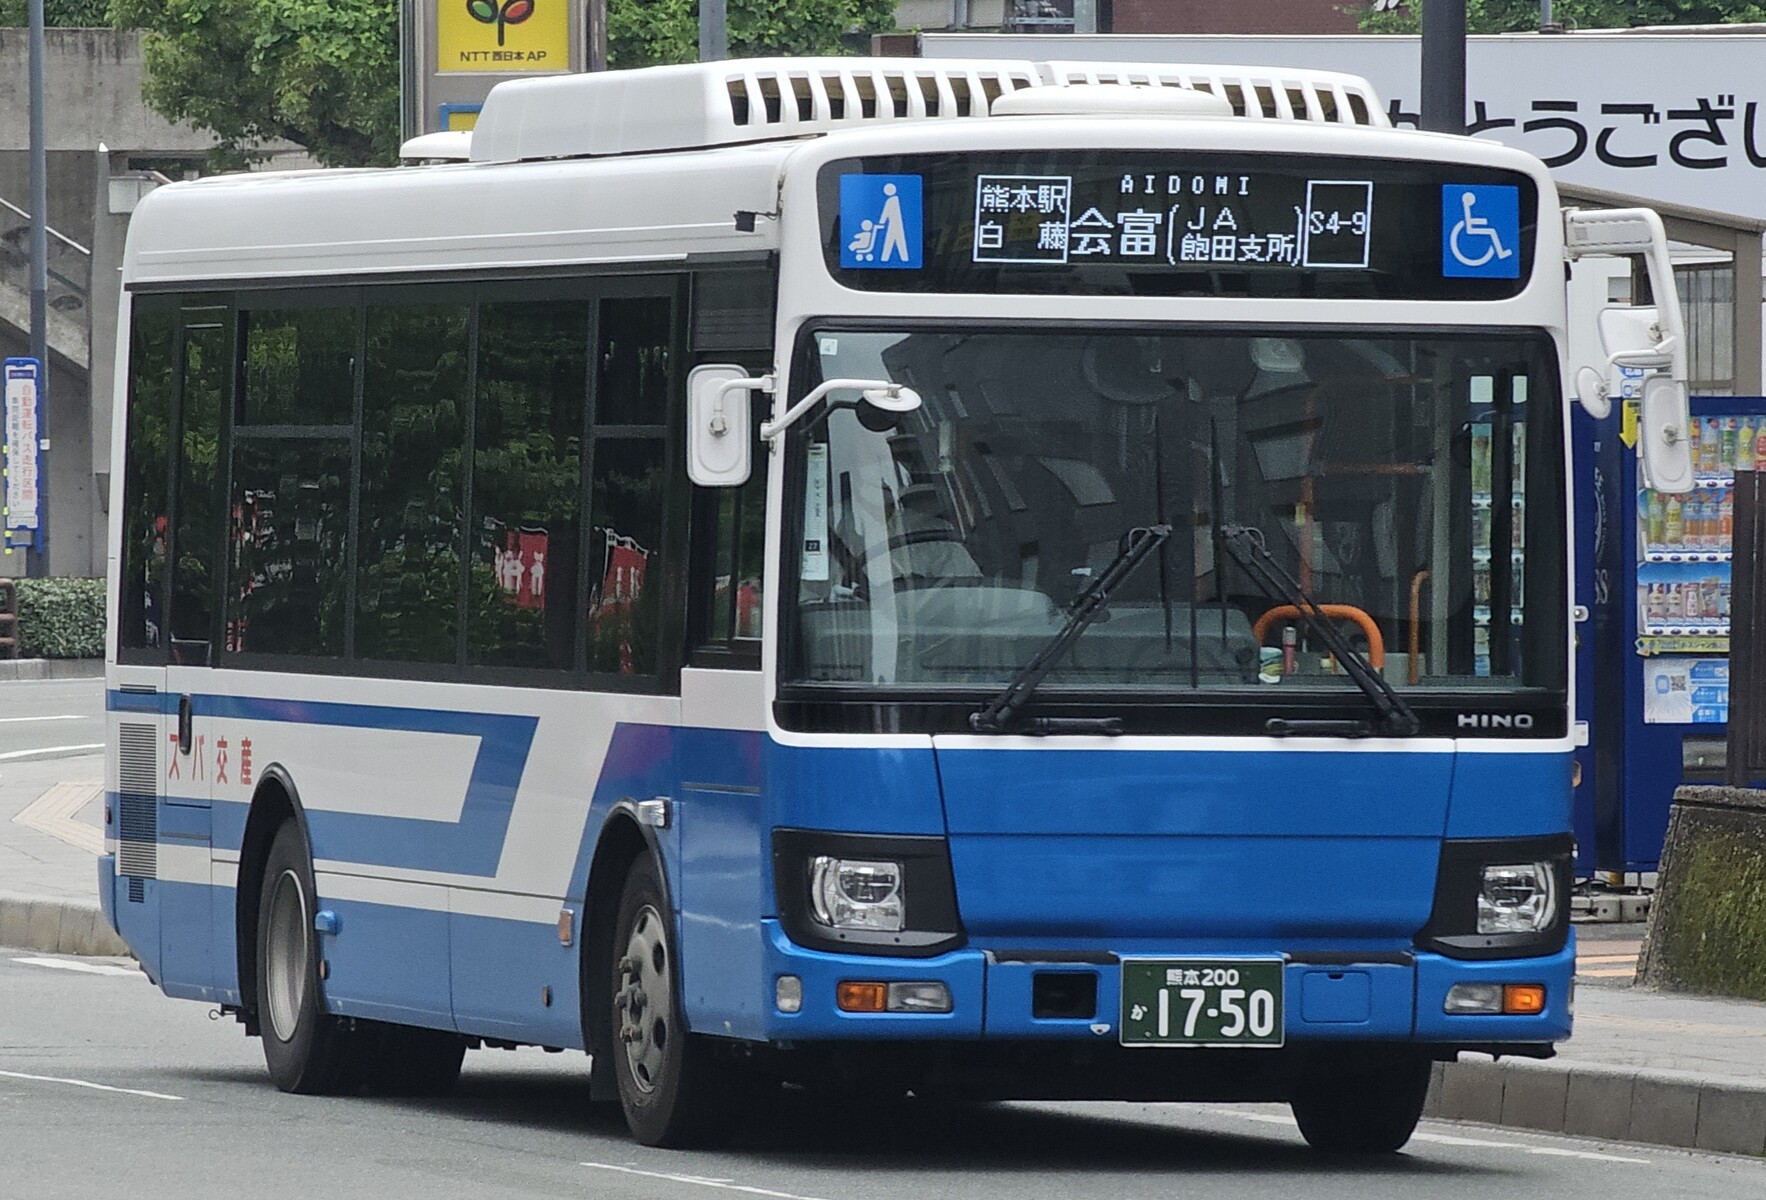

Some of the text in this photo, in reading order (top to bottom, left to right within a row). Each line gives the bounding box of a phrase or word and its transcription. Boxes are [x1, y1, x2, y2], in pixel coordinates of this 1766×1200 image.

[1120, 174, 1250, 195] AIDOMI
[980, 185, 1066, 213] 熊本駅
[1070, 207, 1163, 255] 会富
[1310, 211, 1366, 235] S4-9
[1457, 714, 1533, 728] HINO
[1130, 1004, 1148, 1021] か
